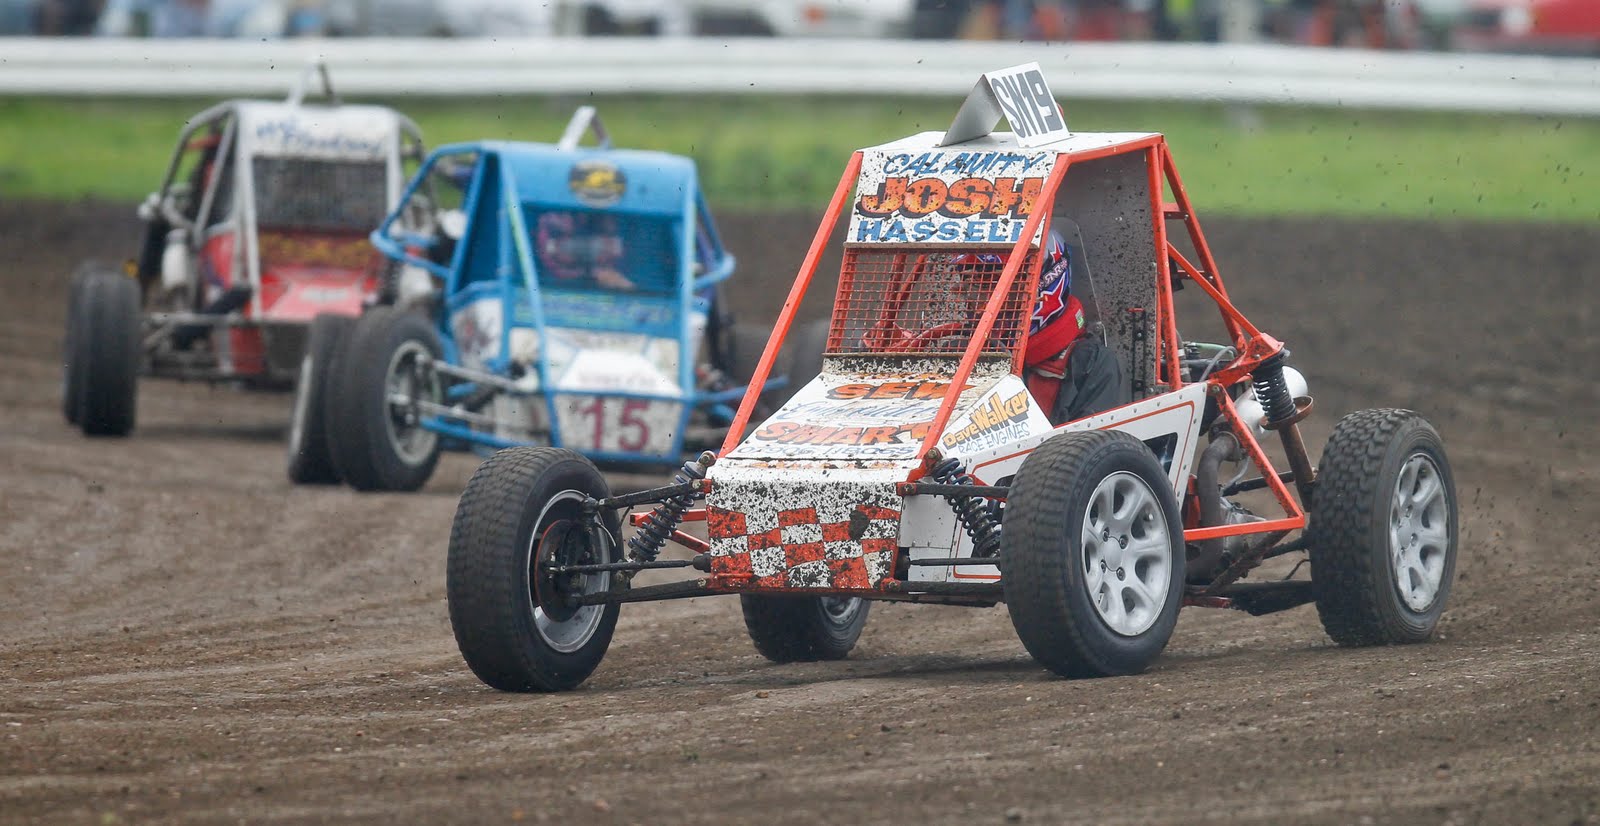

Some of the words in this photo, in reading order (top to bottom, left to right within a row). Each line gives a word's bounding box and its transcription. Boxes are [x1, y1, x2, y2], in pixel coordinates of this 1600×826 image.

[991, 70, 1064, 138] SN19
[883, 151, 1048, 175] CALAMITY
[855, 176, 1045, 220] JOSH
[577, 396, 651, 452] 15
[755, 420, 935, 446] SMART
[968, 388, 1031, 436] Walker
[957, 438, 985, 454] RACE
[984, 421, 1031, 449] ENGINES
